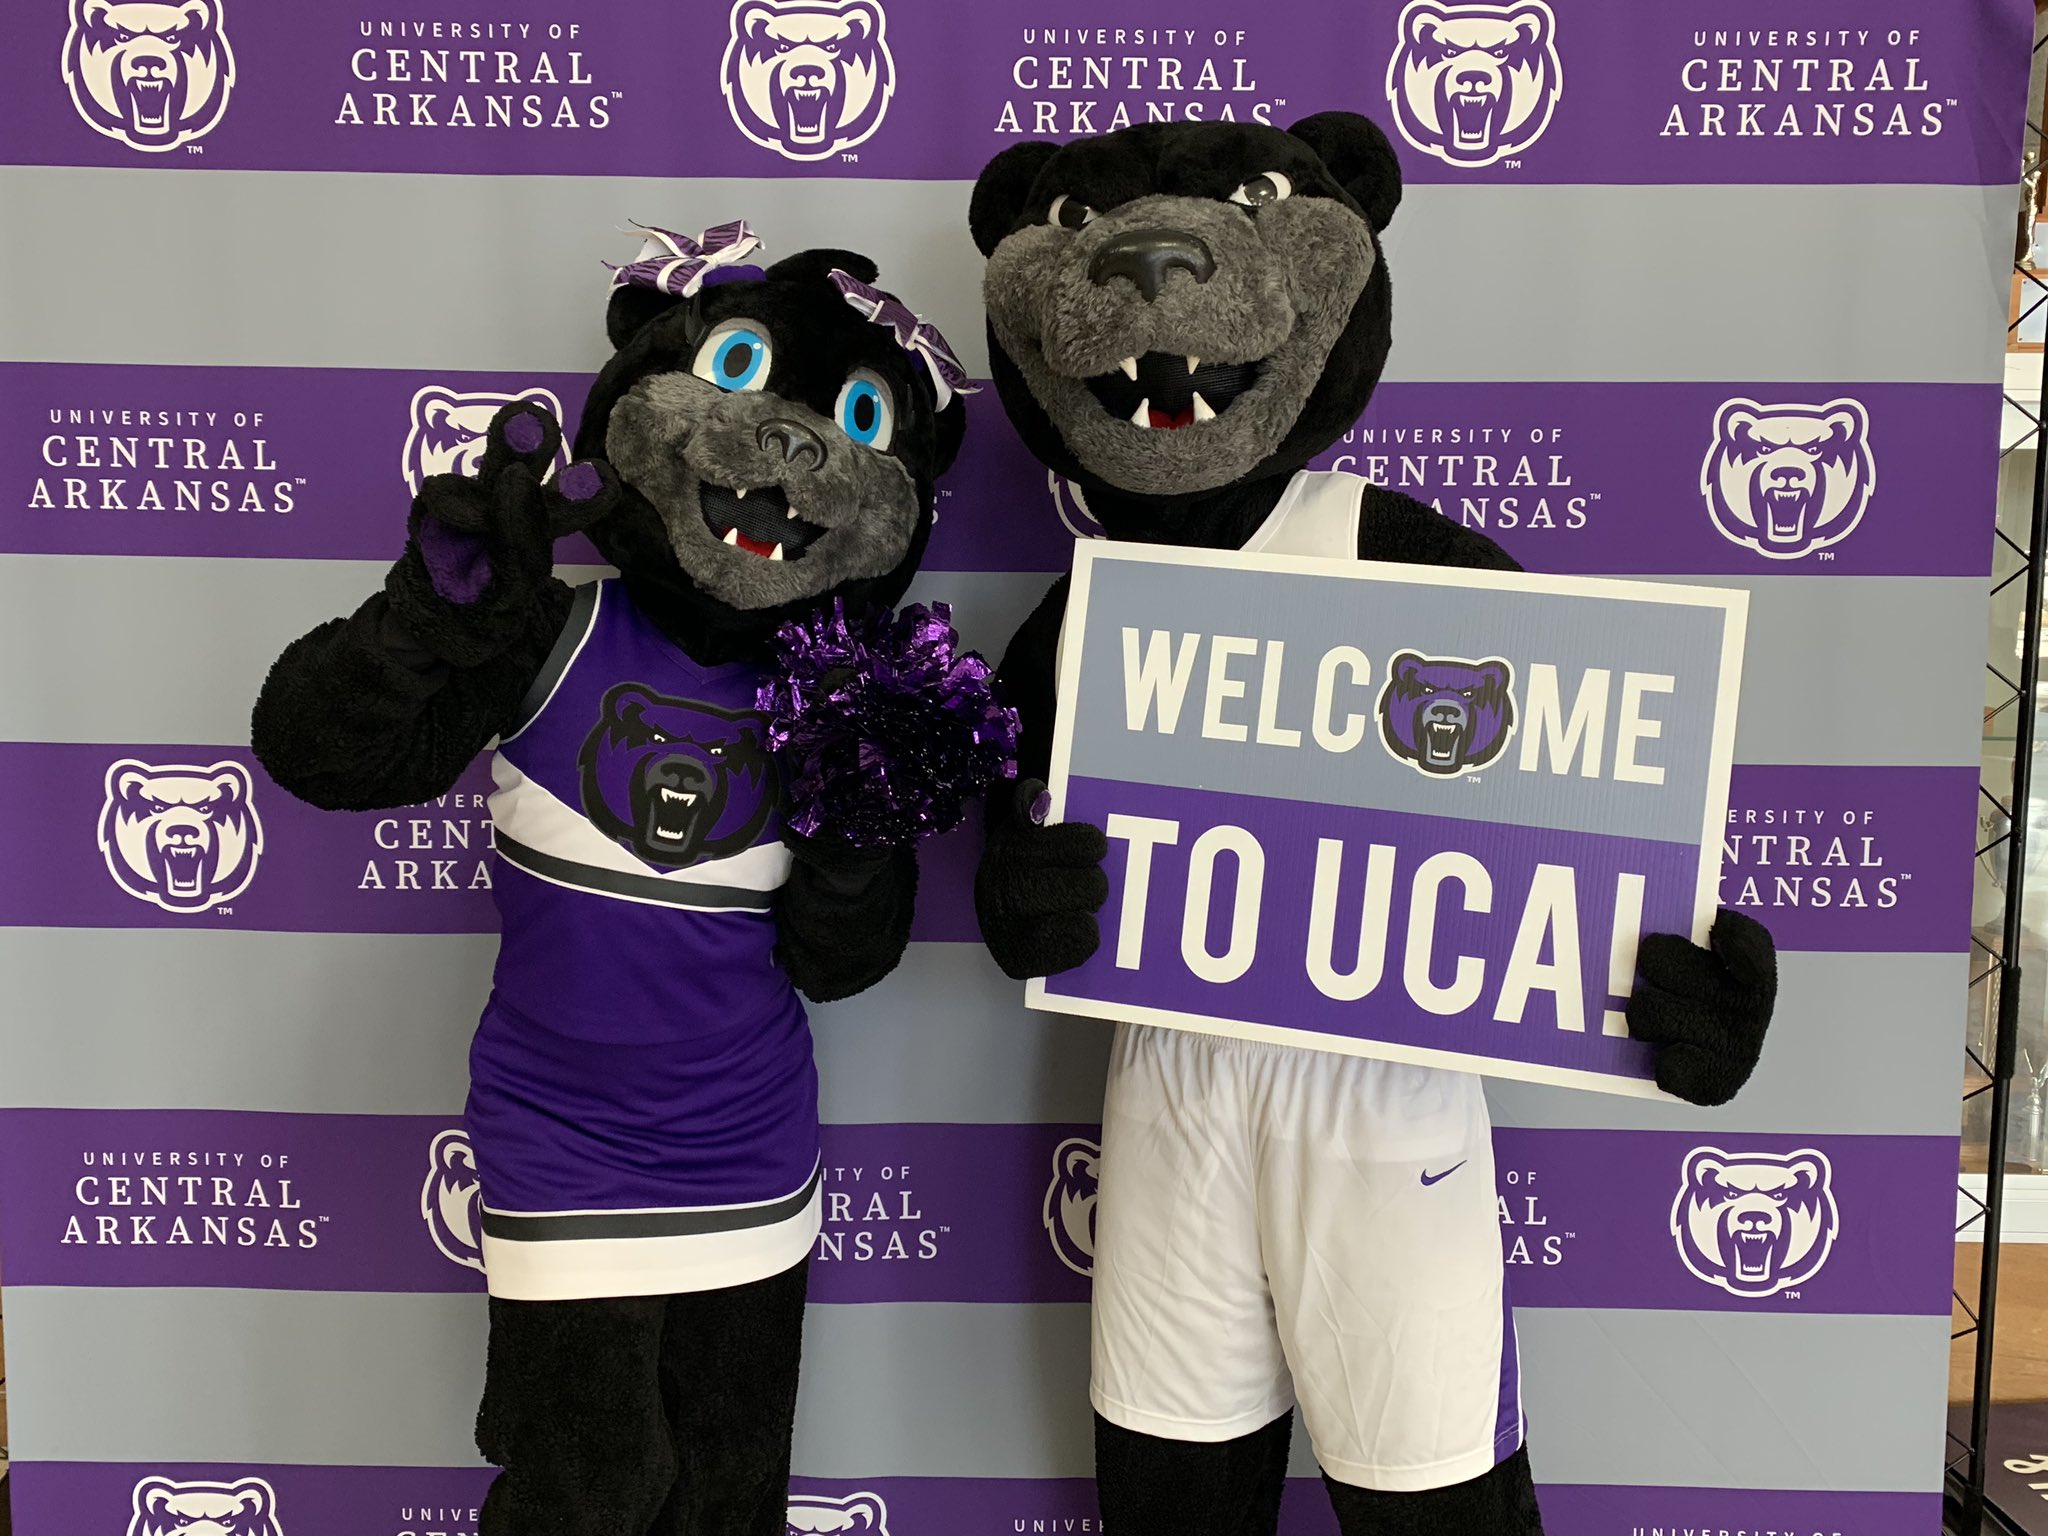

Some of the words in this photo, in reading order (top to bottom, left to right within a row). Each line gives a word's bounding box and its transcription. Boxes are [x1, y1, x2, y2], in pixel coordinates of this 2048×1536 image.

[360, 21, 530, 39] UNIVERSITY
[548, 23, 580, 39] OF
[1023, 28, 1195, 45] UNIVERSITY
[1214, 30, 1246, 46] OF
[1694, 30, 1869, 47] UNIVERSITY
[1887, 29, 1920, 46] OF
[351, 48, 592, 84] CENTRAL
[1013, 56, 1256, 91] CENTRAL
[1681, 58, 1928, 92] CENTRAL
[334, 92, 610, 129] ARKANSAS
[1659, 102, 1942, 137] ARKANSAS
[50, 409, 216, 427] UNIVERSITY
[234, 412, 263, 427] OF
[1343, 428, 1512, 444] UNIVERSITY
[1530, 428, 1562, 443] OF
[42, 435, 276, 471] CENTRAL
[27, 477, 294, 513] ARKANSAS
[1728, 809, 1825, 825] ERSITY
[1843, 810, 1874, 825] OF
[373, 818, 497, 850] CENT
[1720, 834, 1884, 868] NTRAL
[357, 859, 493, 890] ARKA
[1106, 813, 1265, 983] TO
[1306, 838, 1646, 1039] UCA!
[83, 1151, 243, 1167] UNIVERSITY
[260, 1154, 288, 1169] OF
[880, 1166, 910, 1180] OF
[75, 1176, 301, 1209] CENTRAL
[1506, 1170, 1537, 1185] OF
[60, 1215, 318, 1249] ARKANSAS
[817, 1229, 939, 1262] NSAS
[401, 1507, 478, 1522] UNIVE
[1014, 1519, 1104, 1533] UNIVE
